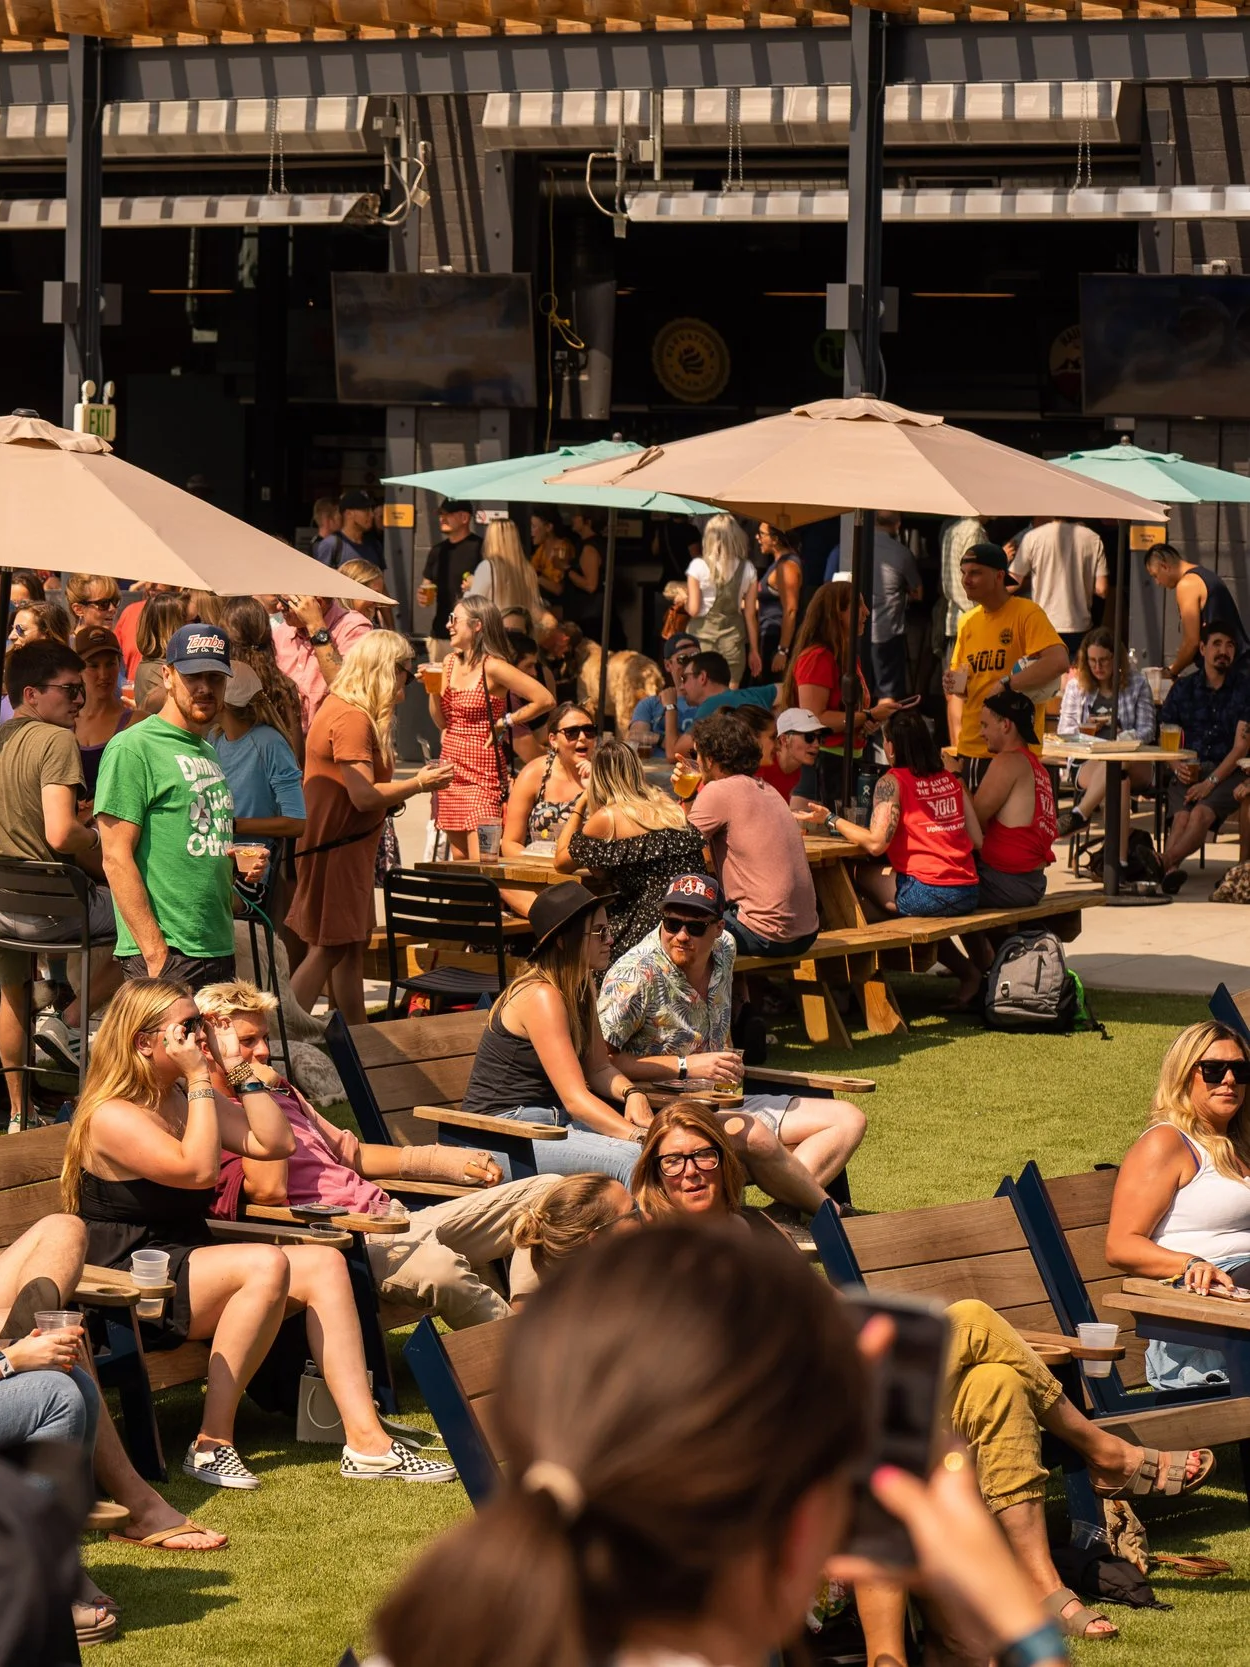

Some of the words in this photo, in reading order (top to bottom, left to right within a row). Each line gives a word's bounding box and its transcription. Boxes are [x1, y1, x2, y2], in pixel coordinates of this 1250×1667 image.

[89, 409, 111, 437] EXIT
[186, 634, 225, 650] Tamba
[967, 649, 1006, 673] VOLO
